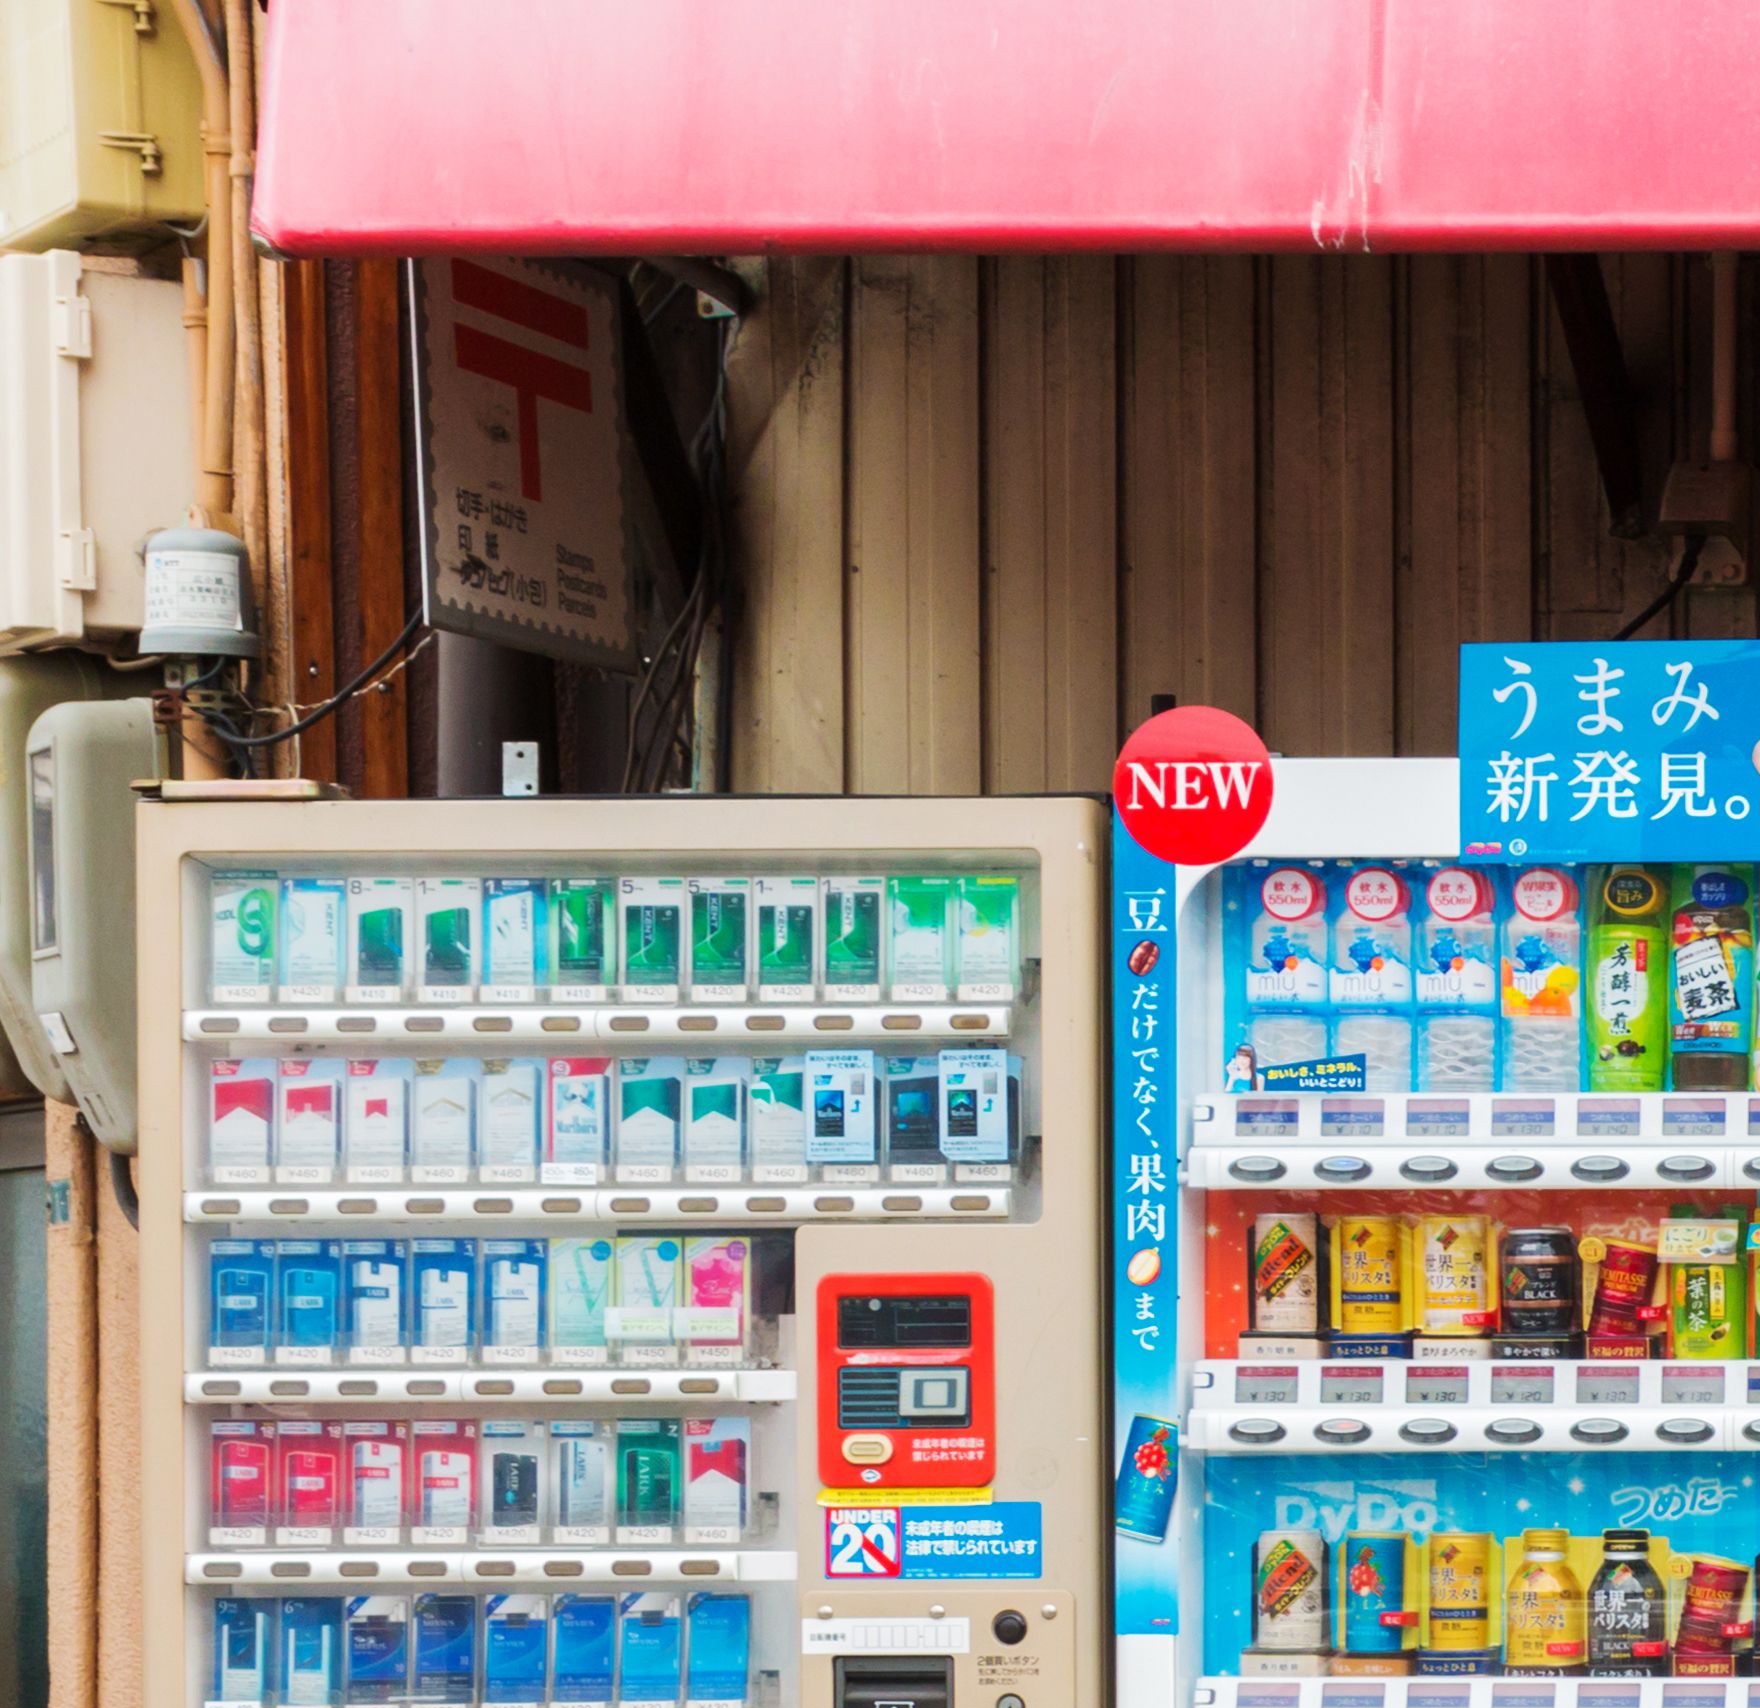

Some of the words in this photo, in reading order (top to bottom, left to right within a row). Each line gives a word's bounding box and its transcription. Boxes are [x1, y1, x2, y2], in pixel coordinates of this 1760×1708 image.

[1491, 656, 1720, 738] うまみ
[1126, 761, 1261, 809] NEW
[1486, 749, 1749, 823] 新発見。
[1125, 888, 1168, 933] 豆
[1134, 1292, 1156, 1352] まで
[831, 1508, 896, 1524] UNDER
